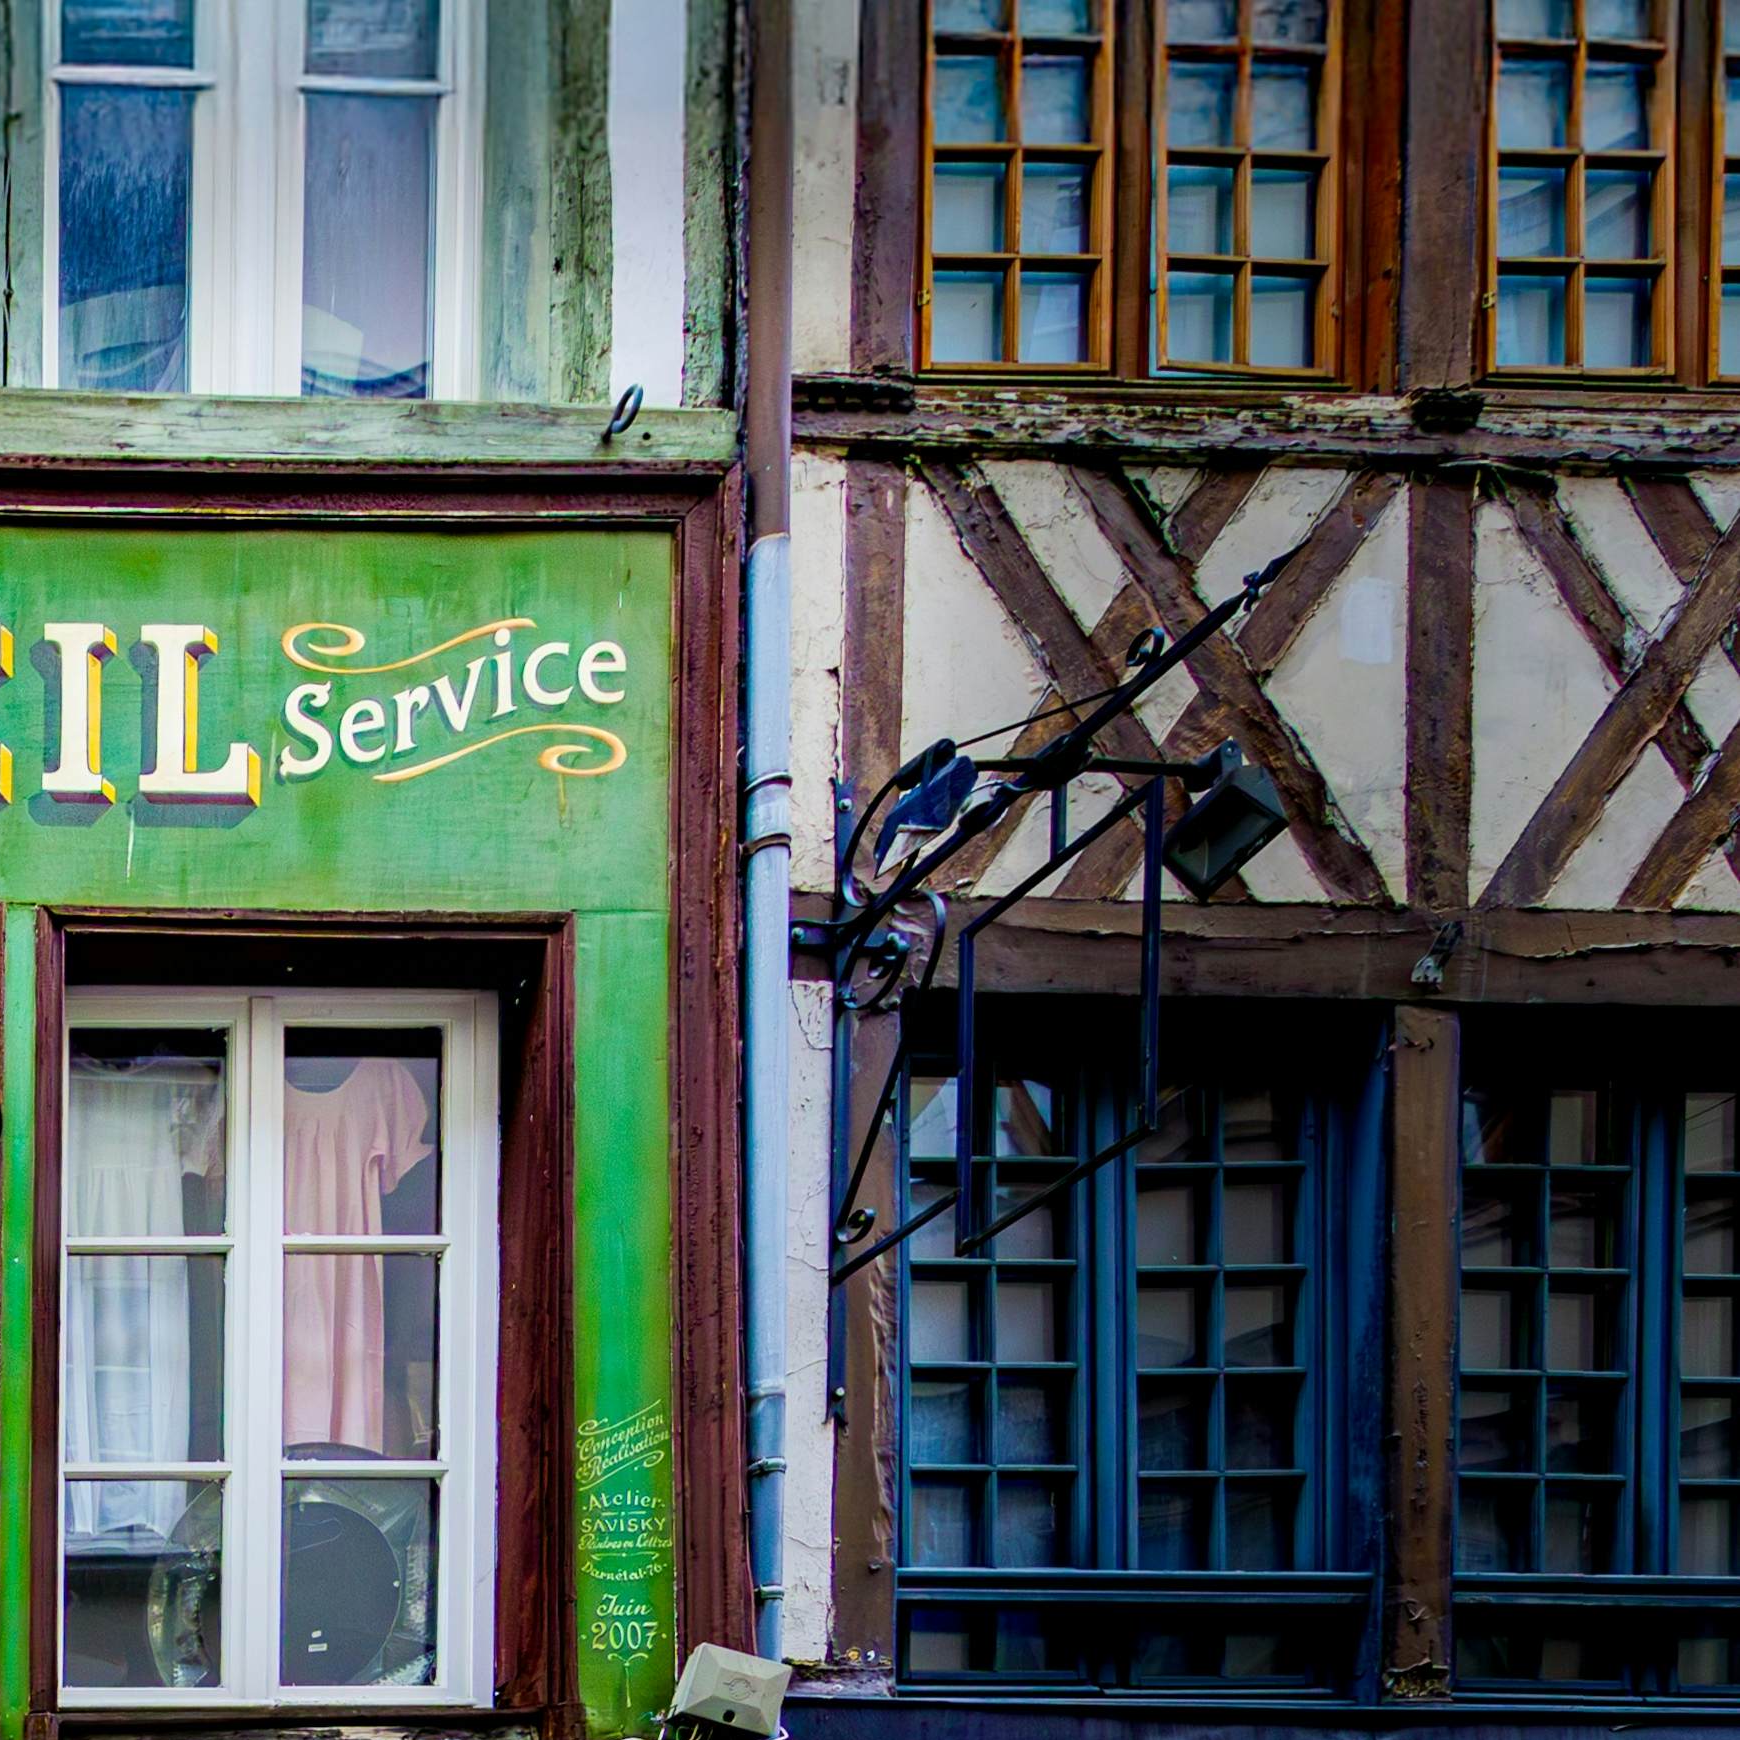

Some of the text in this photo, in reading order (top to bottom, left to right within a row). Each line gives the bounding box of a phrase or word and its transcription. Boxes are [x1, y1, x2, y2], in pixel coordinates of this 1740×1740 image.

[278, 618, 628, 781] Service
[577, 1415, 663, 1461] Conception
[588, 1489, 661, 1512] Atelier
[581, 1518, 666, 1533] SAVISKY
[596, 1593, 651, 1618] Juin
[591, 1621, 659, 1651] 2007
